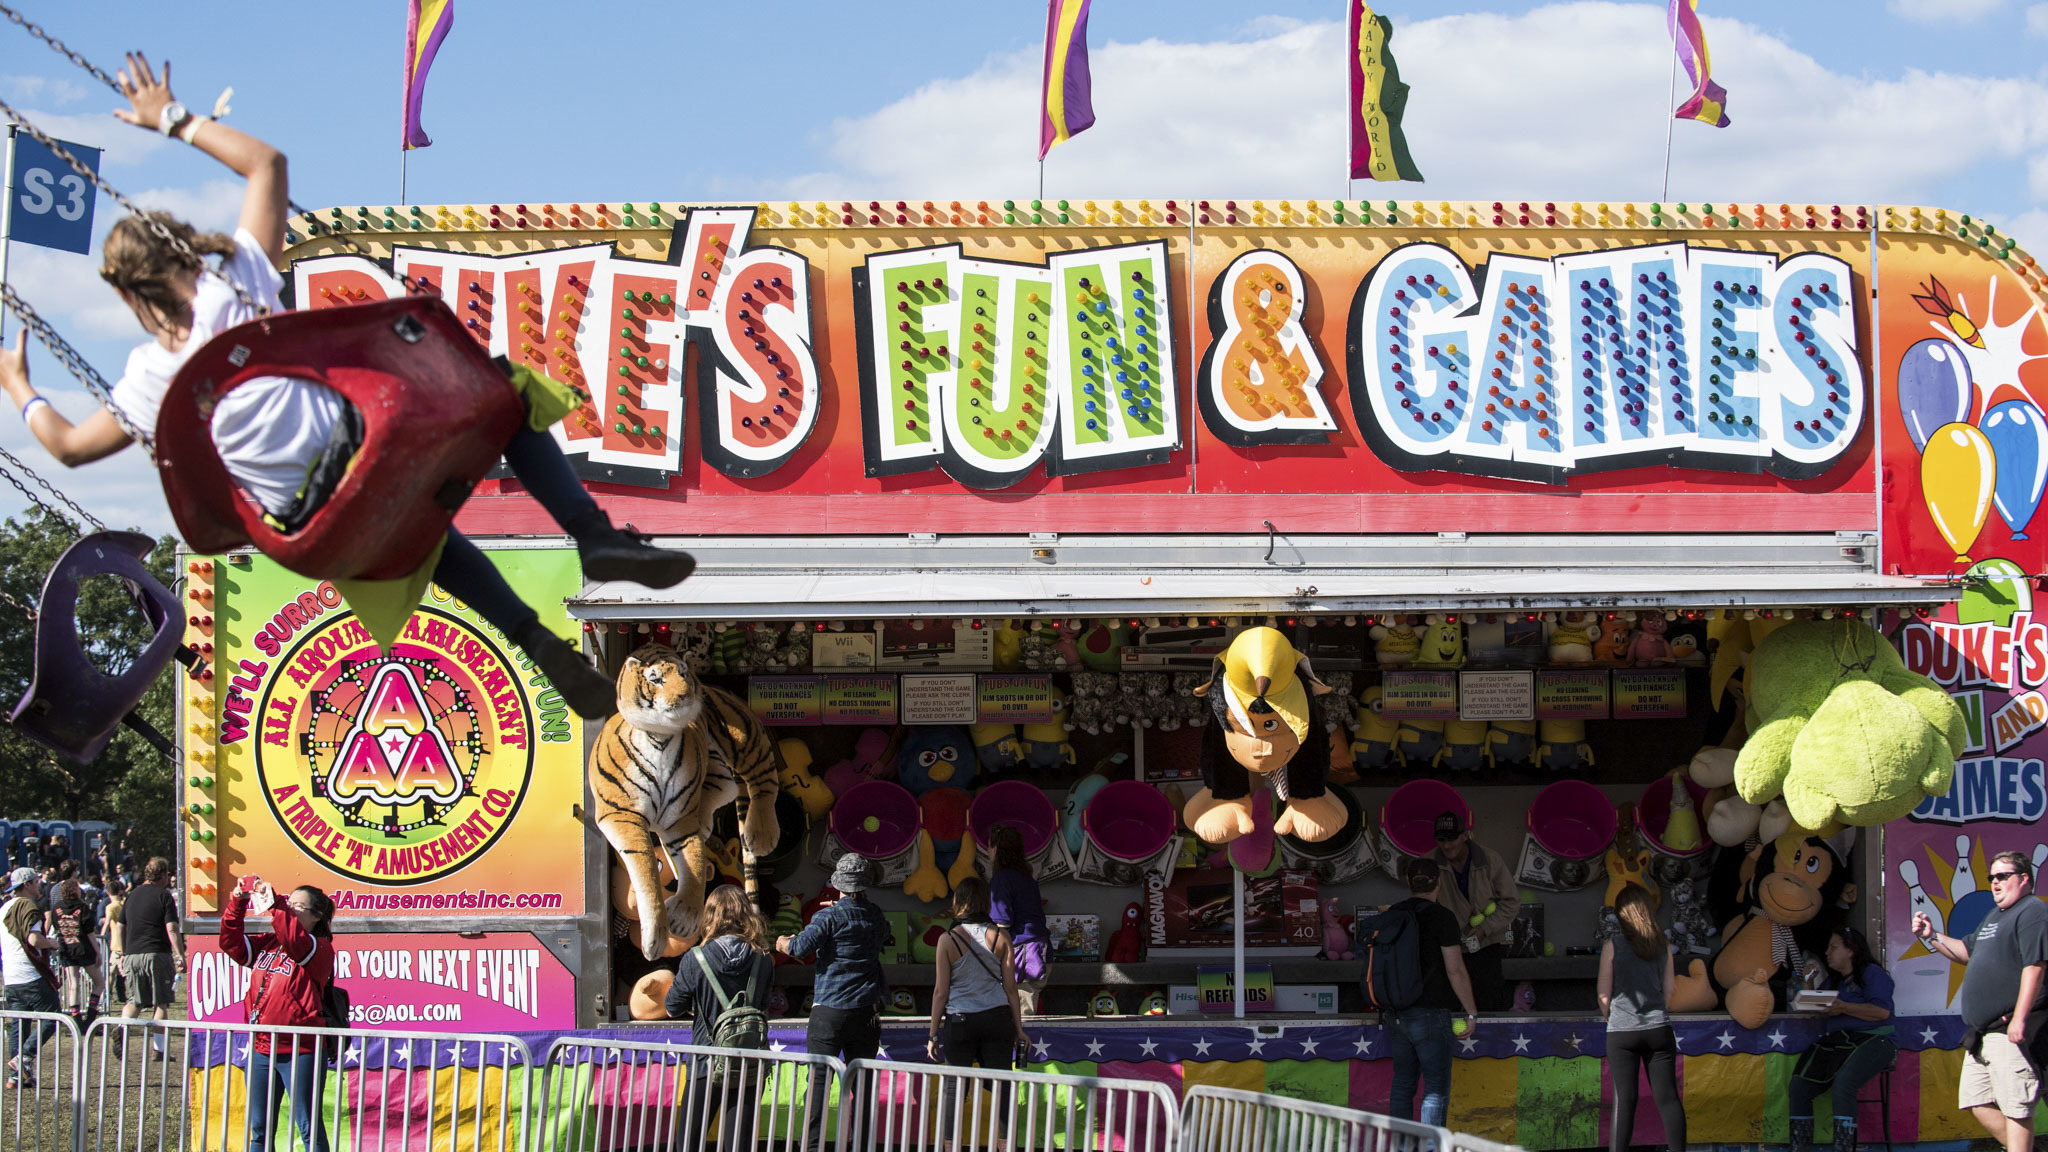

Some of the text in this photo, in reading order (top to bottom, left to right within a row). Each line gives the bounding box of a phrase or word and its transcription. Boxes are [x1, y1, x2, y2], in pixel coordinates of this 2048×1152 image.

[1368, 102, 1387, 172] WORLD
[20, 167, 87, 222] S3
[866, 243, 1180, 473] FUN
[1212, 250, 1338, 433] &
[1362, 242, 1862, 468] GAMES
[835, 637, 853, 646] Wii
[1904, 611, 2047, 688] DUKE'S
[263, 696, 298, 748] ALL
[286, 618, 374, 690] AROUN
[402, 614, 527, 751] AMUSEMENT
[828, 680, 855, 693] TUBS
[873, 679, 892, 693] FUN
[983, 679, 1010, 692] TUBS
[1027, 679, 1047, 692] FUN
[1624, 684, 1675, 692] YOUR FINANCES
[220, 658, 269, 745] WE'LL
[759, 691, 812, 699] YOUR FINANCES
[982, 694, 995, 702] RIM
[995, 694, 1016, 702] SHOTS
[1017, 694, 1024, 702] IN
[1035, 694, 1047, 702] OUT
[1638, 695, 1662, 703] DO NOT
[773, 702, 798, 711] DO NOT
[1002, 703, 1028, 711] DO OVER
[765, 711, 806, 720] OVERSPEND
[1992, 690, 2047, 752] AND
[1912, 757, 2046, 821] AMES
[273, 783, 516, 876] A TRIPLE "A" AMUSEMENT CO.
[1293, 926, 1314, 938] 40
[190, 951, 252, 1021] CONTA
[356, 950, 413, 981] YOUR
[418, 949, 472, 993] NEXT
[476, 948, 541, 1020] EVENT
